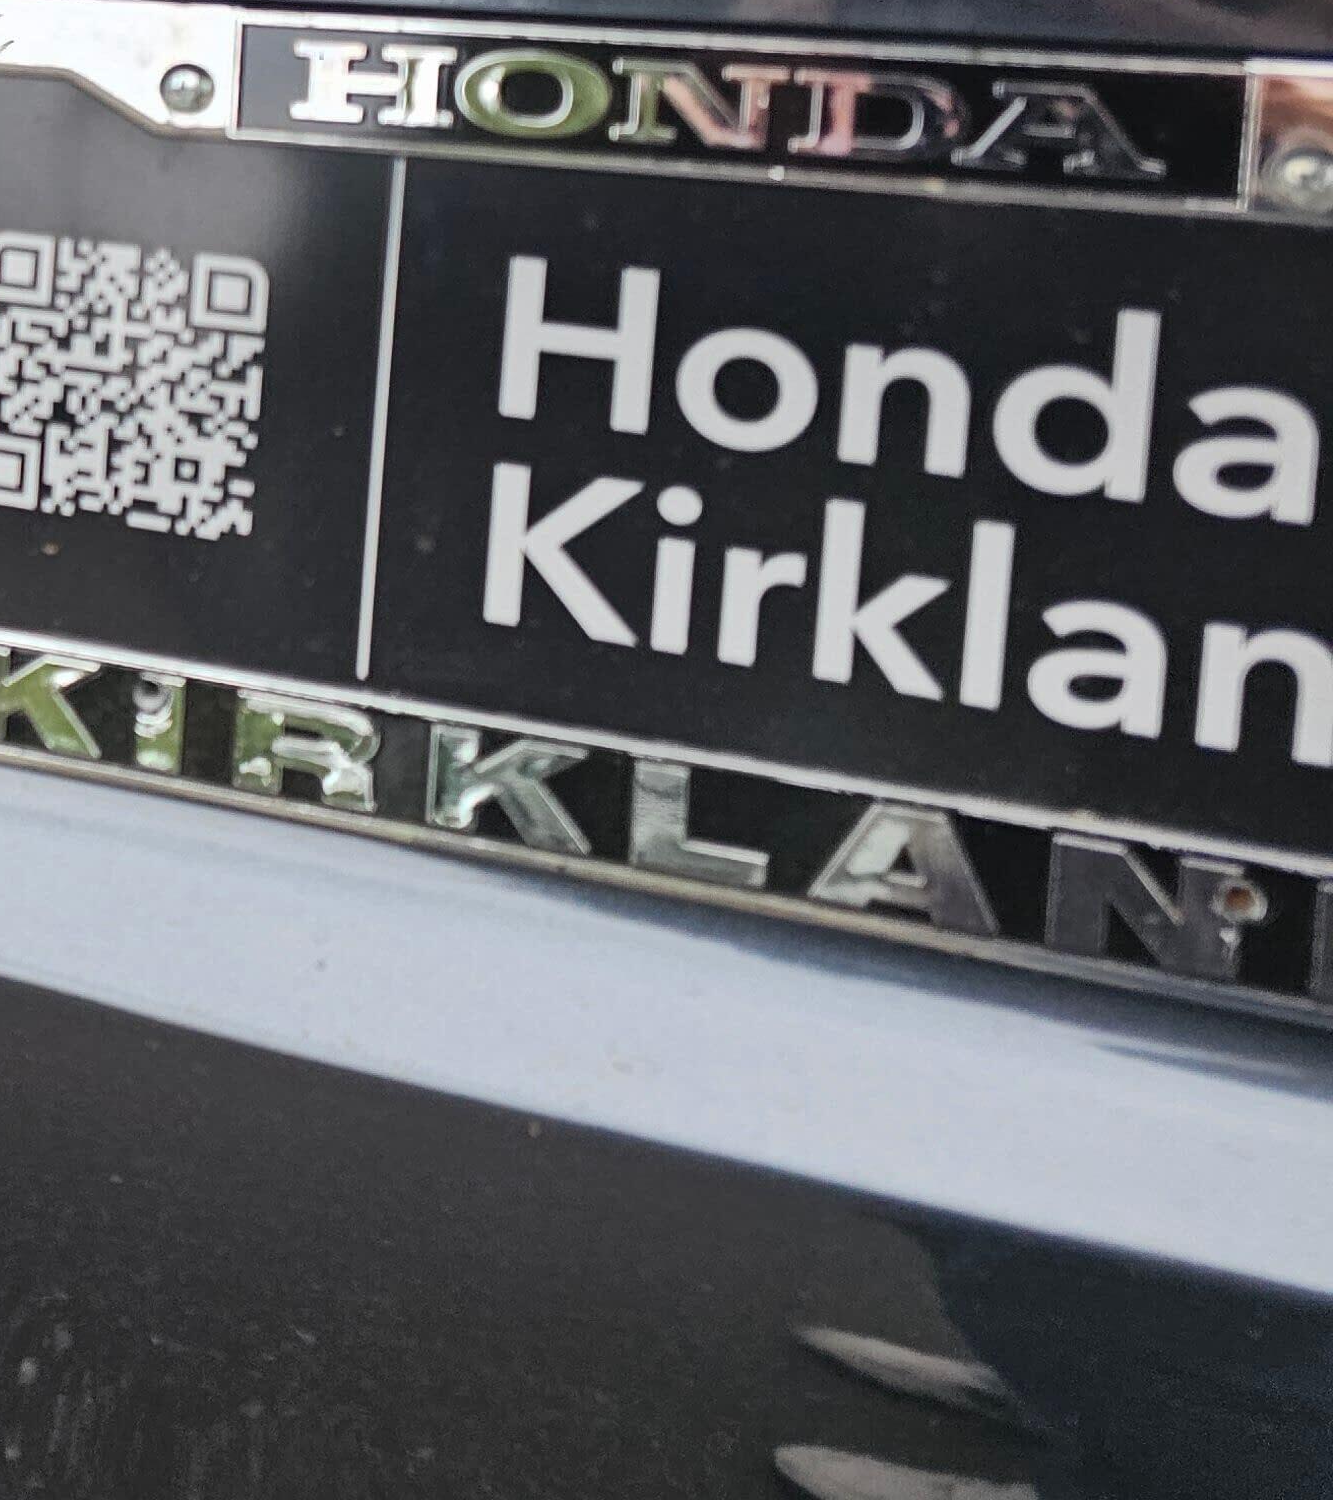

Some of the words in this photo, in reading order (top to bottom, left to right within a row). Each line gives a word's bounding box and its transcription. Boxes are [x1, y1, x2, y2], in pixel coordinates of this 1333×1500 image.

[288, 38, 1167, 182] HONDA
[496, 254, 1321, 526] Honda
[481, 460, 1333, 769] Kirklan
